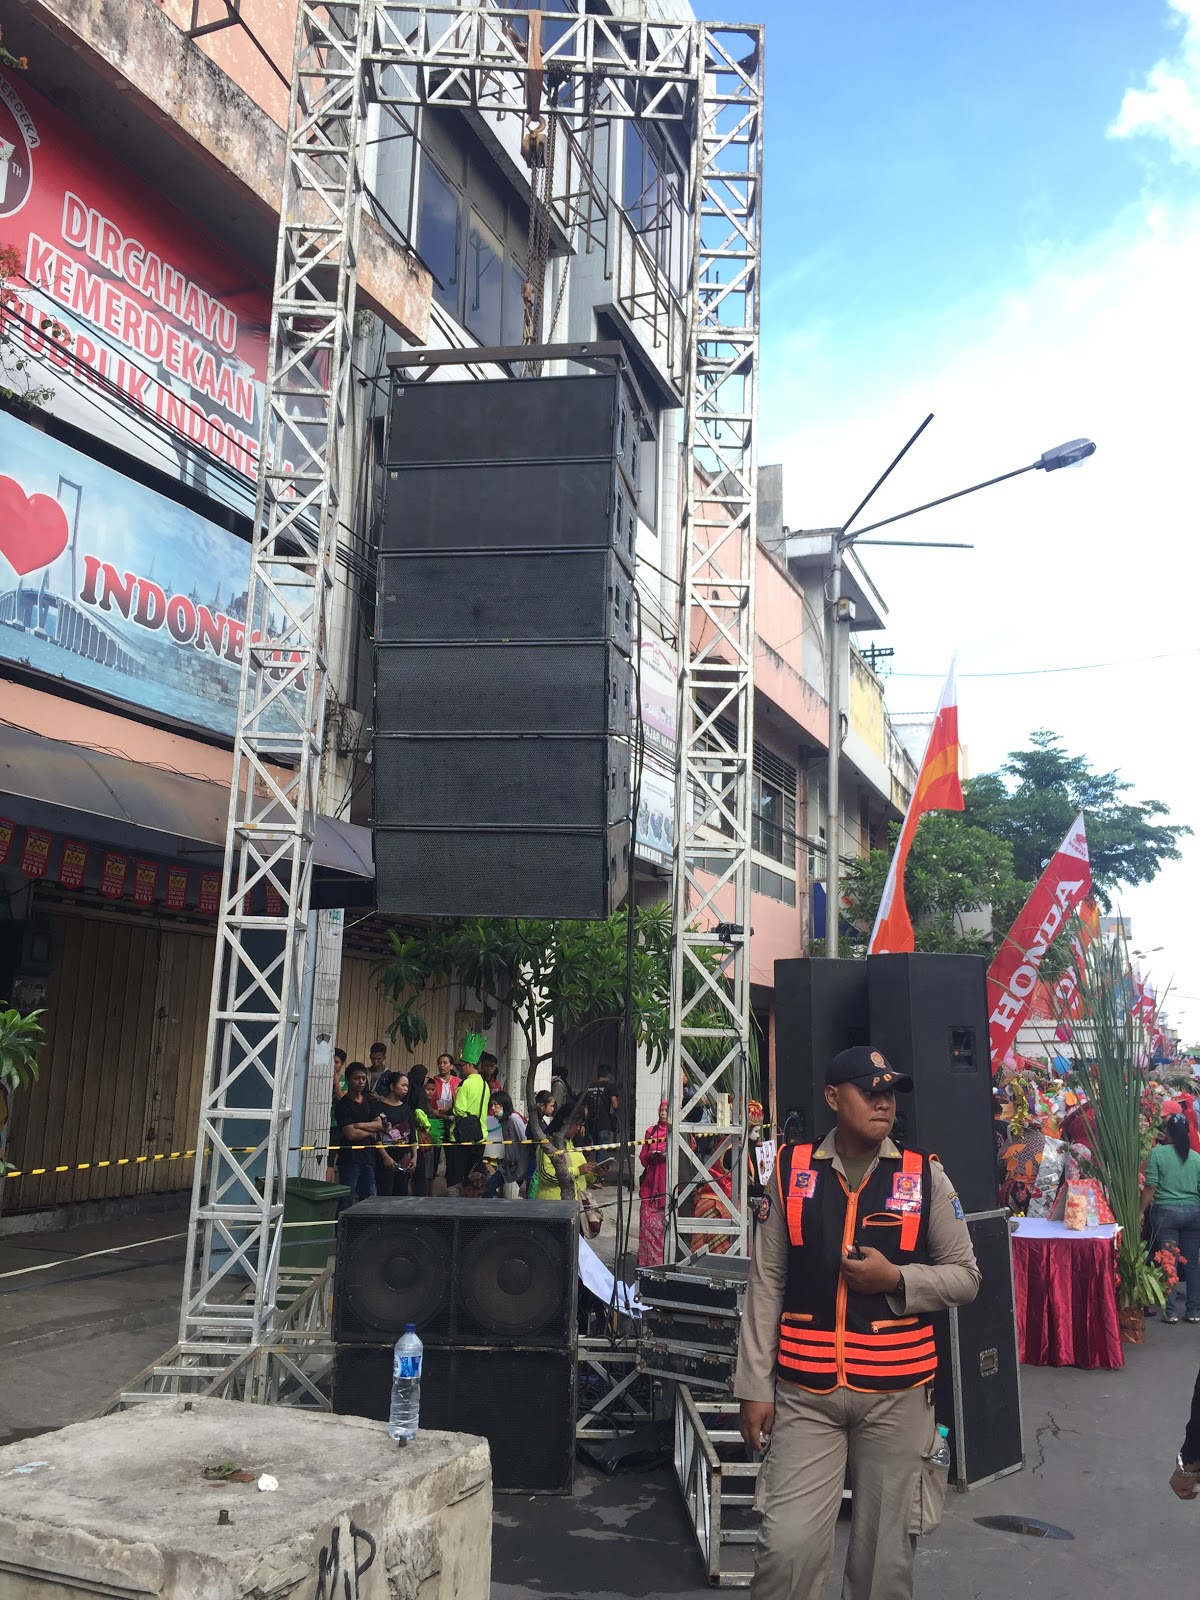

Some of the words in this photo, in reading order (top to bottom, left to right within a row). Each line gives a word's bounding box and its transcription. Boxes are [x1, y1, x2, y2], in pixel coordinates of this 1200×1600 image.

[0, 74, 39, 146] ERDEKA
[12, 161, 22, 178] TH
[62, 191, 238, 354] DIRGAHAYU
[26, 232, 256, 424] KEMERDEKAAN
[22, 863, 44, 875] KIKY
[60, 875, 81, 886] KIKY
[102, 884, 122, 895] KIKY
[989, 879, 1085, 1033] HONDA
[872, 1071, 902, 1088] PO
